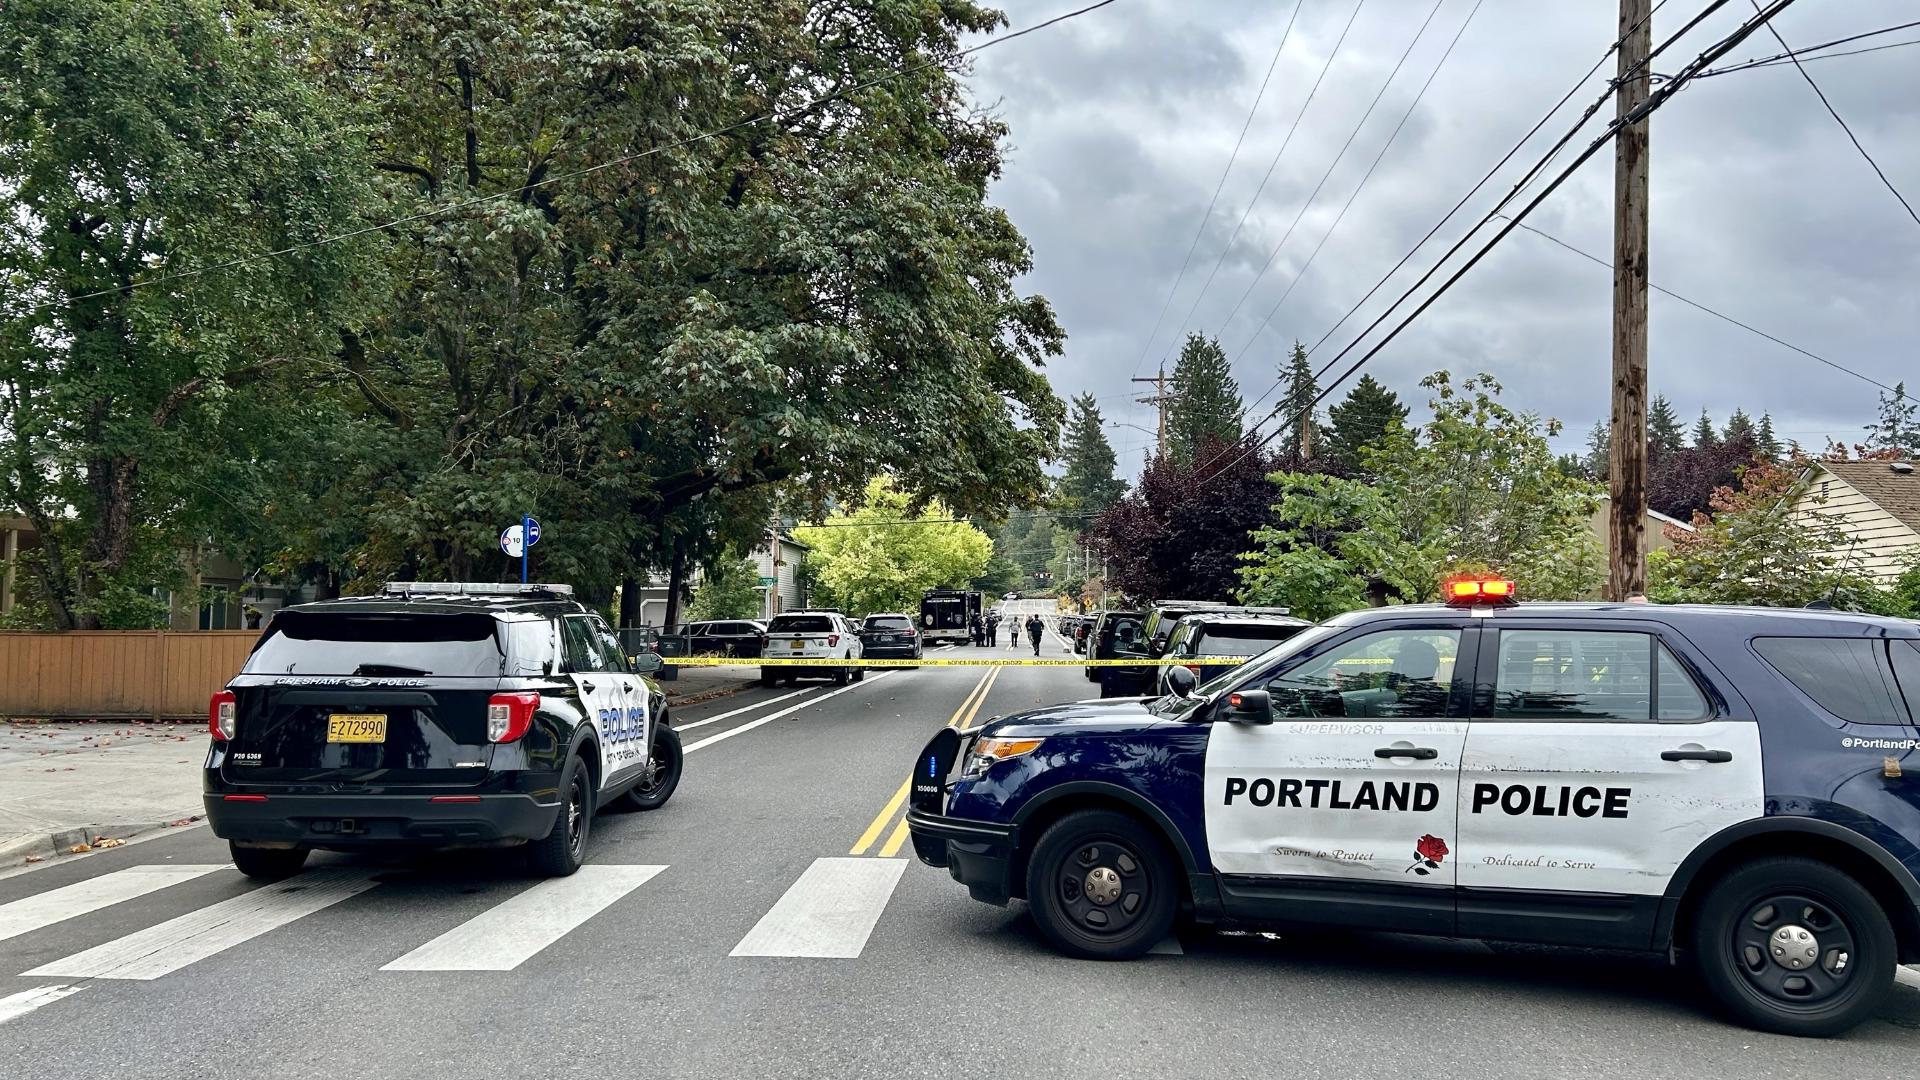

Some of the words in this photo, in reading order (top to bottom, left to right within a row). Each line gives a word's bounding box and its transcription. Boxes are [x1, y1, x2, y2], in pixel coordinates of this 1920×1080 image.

[276, 678, 340, 686] GRESHAM
[377, 678, 426, 686] POLICE
[330, 720, 382, 736] E272990
[598, 707, 644, 746] POLICE
[1289, 724, 1385, 734] SUPERVISOR
[1842, 738, 1920, 750] @PortlandPo
[1224, 777, 1439, 812] PORTLAND
[1472, 783, 1632, 818] POLICE
[1274, 847, 1311, 857] Sworn
[1316, 848, 1326, 858] to
[1332, 849, 1374, 861] Protect
[1482, 854, 1544, 867] Dedicated
[1546, 859, 1558, 868] to
[1562, 860, 1596, 870] Serve
